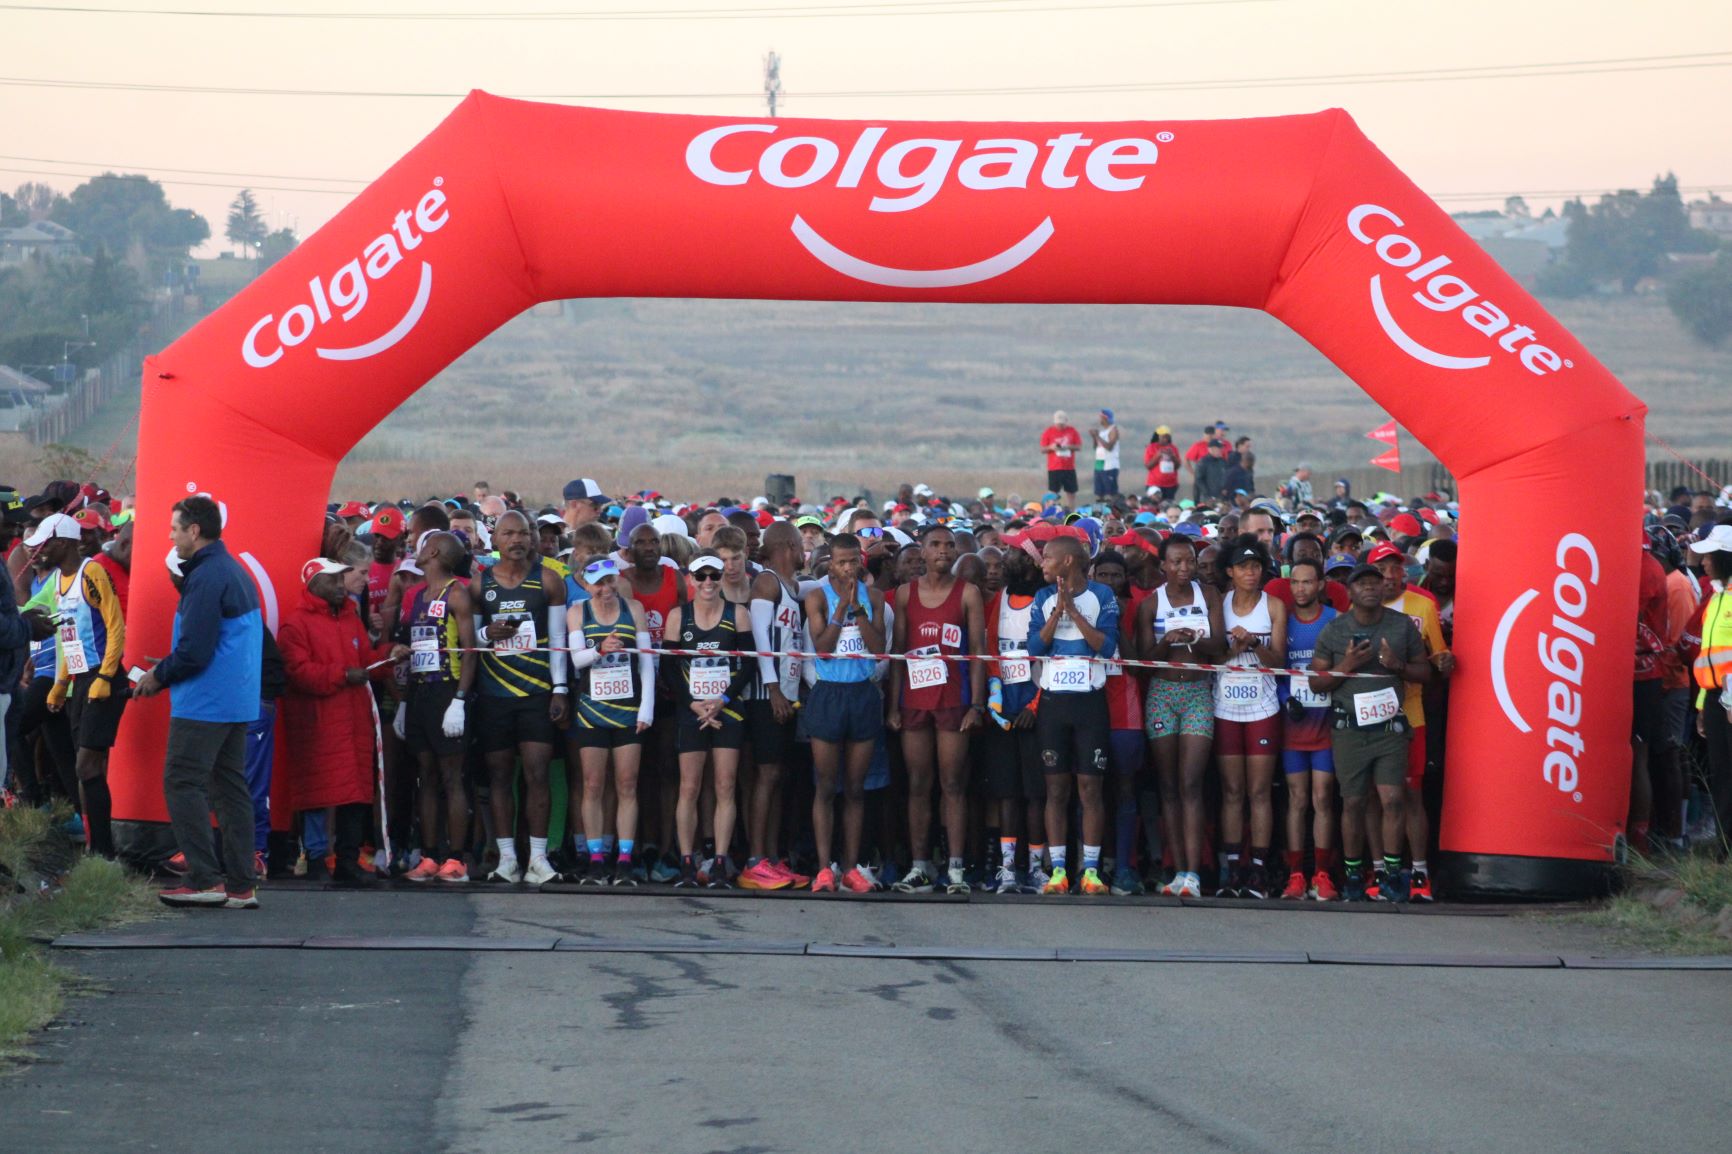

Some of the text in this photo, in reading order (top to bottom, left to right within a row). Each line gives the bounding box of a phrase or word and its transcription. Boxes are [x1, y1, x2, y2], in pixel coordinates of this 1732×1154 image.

[685, 124, 1159, 213] Colgate
[241, 188, 449, 368] Colgate
[1347, 203, 1562, 375] Colgate
[430, 604, 443, 617] 45
[944, 628, 959, 643] 40
[1542, 532, 1600, 792] Colgate
[911, 666, 942, 685] 6326
[1053, 671, 1086, 685] 4282
[594, 679, 630, 696] 5588
[693, 679, 728, 695] 5589
[1223, 685, 1258, 699] 3088
[1360, 701, 1396, 721] 5435
